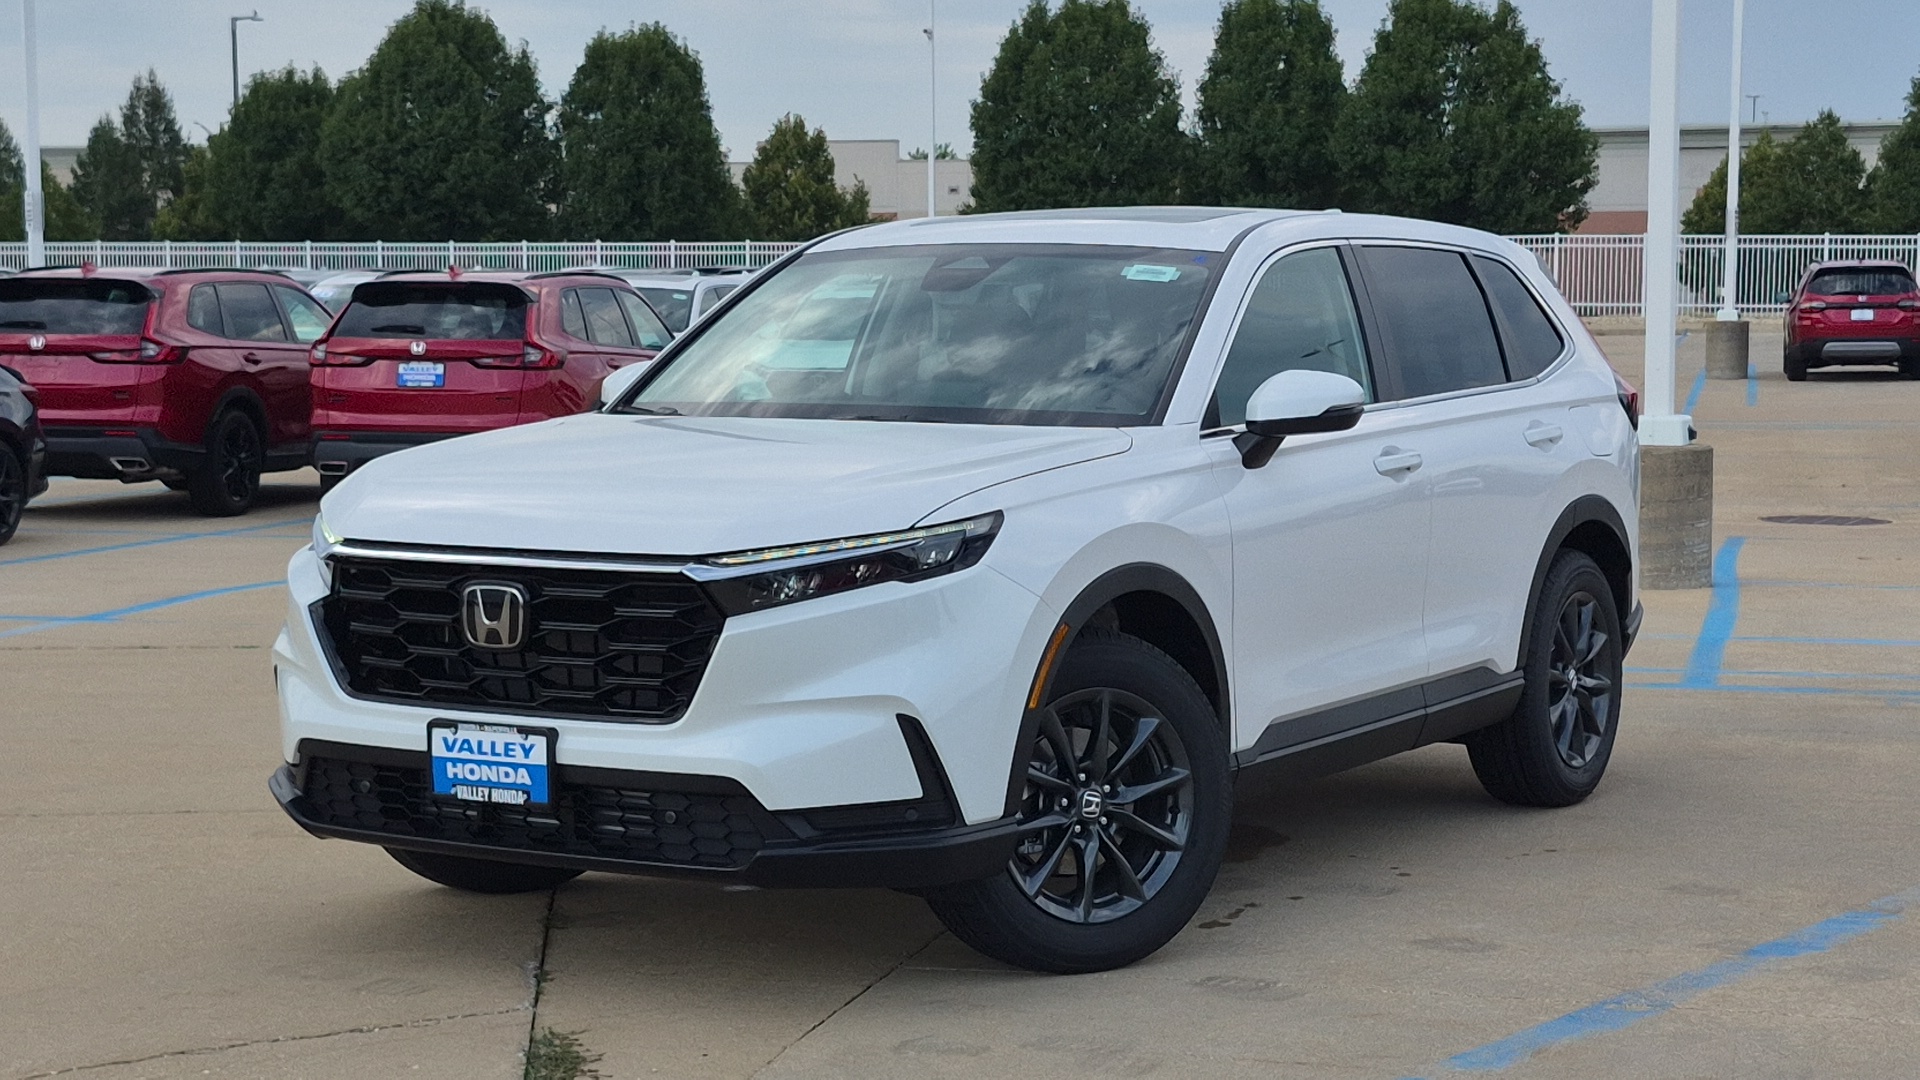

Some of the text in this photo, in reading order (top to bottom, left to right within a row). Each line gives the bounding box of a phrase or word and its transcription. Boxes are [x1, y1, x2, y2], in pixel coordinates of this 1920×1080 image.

[441, 736, 536, 759] VALLEY
[446, 761, 532, 786] HONDA
[456, 785, 524, 805] VALLEY HONDA
